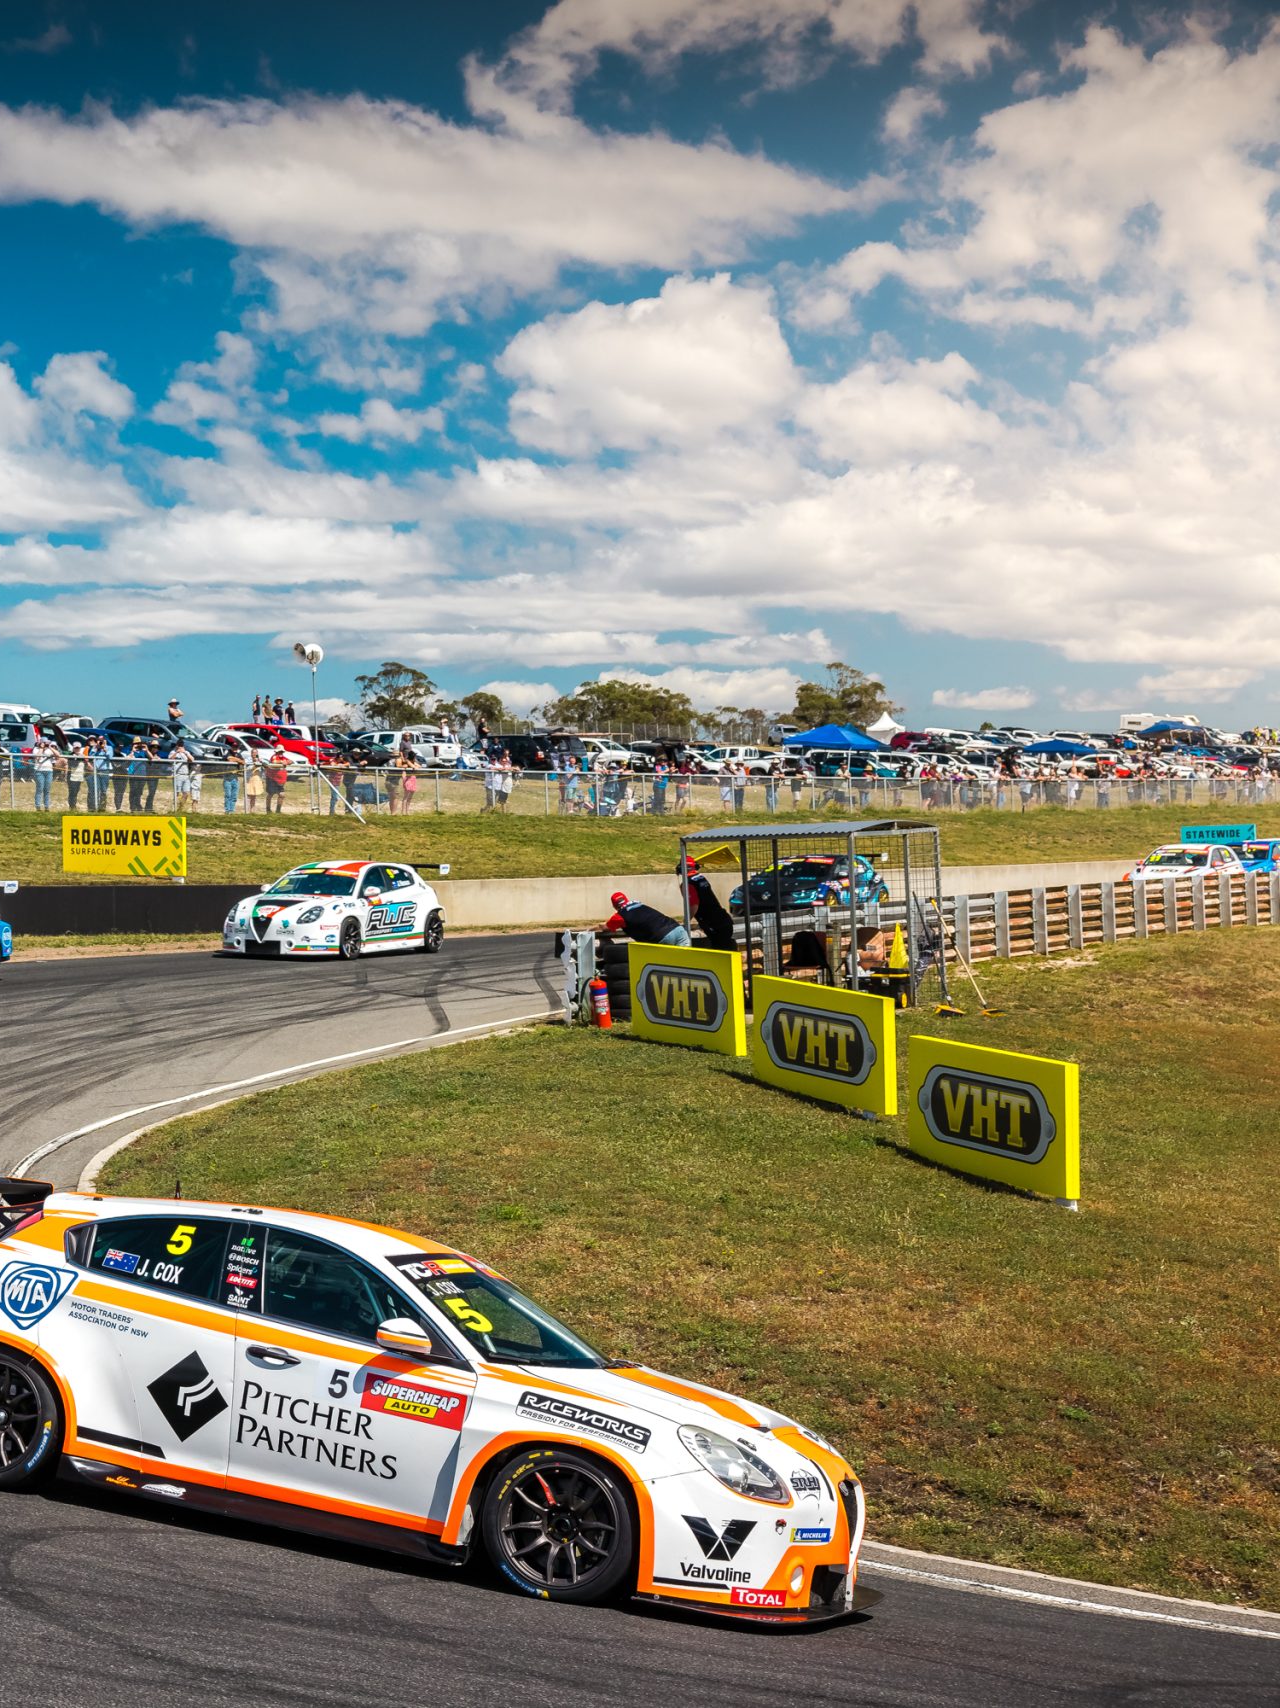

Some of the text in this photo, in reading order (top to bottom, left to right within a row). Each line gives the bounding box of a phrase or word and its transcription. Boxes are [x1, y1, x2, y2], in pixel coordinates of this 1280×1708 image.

[70, 829, 162, 846] ROADWAYS
[1185, 829, 1241, 839] STATEWIDE
[366, 903, 417, 930] AWC
[650, 974, 711, 1021] VHT
[778, 1013, 855, 1072] VHT
[939, 1078, 1031, 1148] VHT
[166, 1224, 197, 1255] 5
[136, 1258, 184, 1285] J. COX
[236, 1255, 259, 1265] BOSCH
[6, 1273, 51, 1312] MTA
[229, 1275, 256, 1287] LOCTITE
[70, 1301, 134, 1324] MOTOR TRADERS'
[227, 1294, 251, 1306] SAINT
[68, 1310, 149, 1339] ASSOCIATION OF NSW
[443, 1298, 494, 1333] 5
[327, 1368, 350, 1399] 5
[370, 1379, 460, 1412] SUPERCHEAP
[239, 1379, 374, 1441] PITCHER
[391, 1401, 431, 1416] AUTO
[523, 1394, 645, 1441] RACEWORKS
[520, 1409, 641, 1451] PASSION FOR PERFORMANCE
[235, 1413, 398, 1480] PARTNERS
[801, 1531, 828, 1539] MICHELIN
[679, 1561, 751, 1584] Valvoline
[735, 1588, 783, 1606] TOTAL
